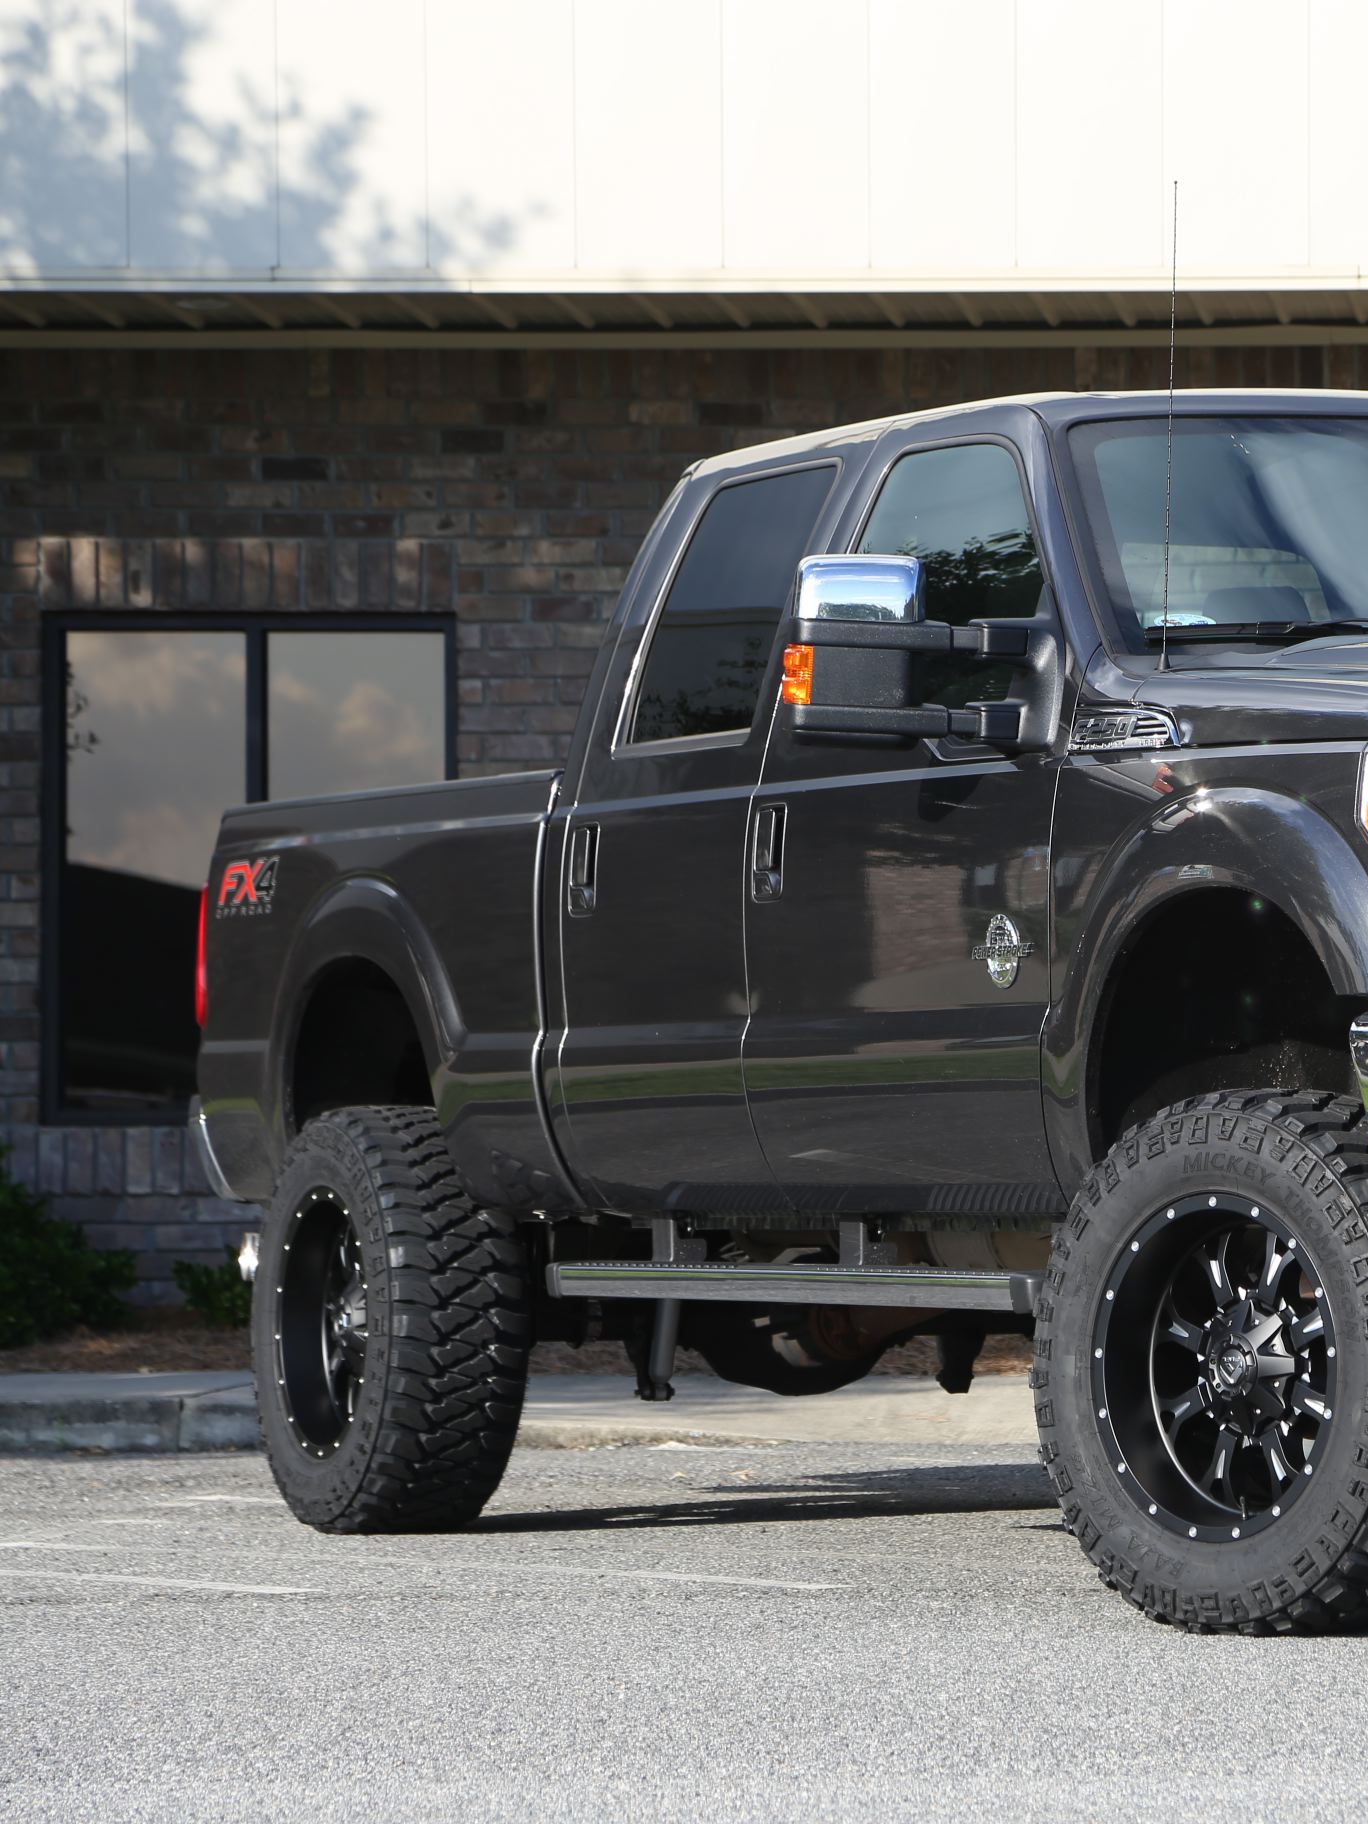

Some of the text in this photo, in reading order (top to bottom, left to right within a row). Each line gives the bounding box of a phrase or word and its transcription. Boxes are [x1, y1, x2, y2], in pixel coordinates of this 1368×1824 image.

[218, 855, 280, 906] FX4
[240, 902, 273, 917] ROAD
[1183, 1151, 1277, 1185] MICKEY
